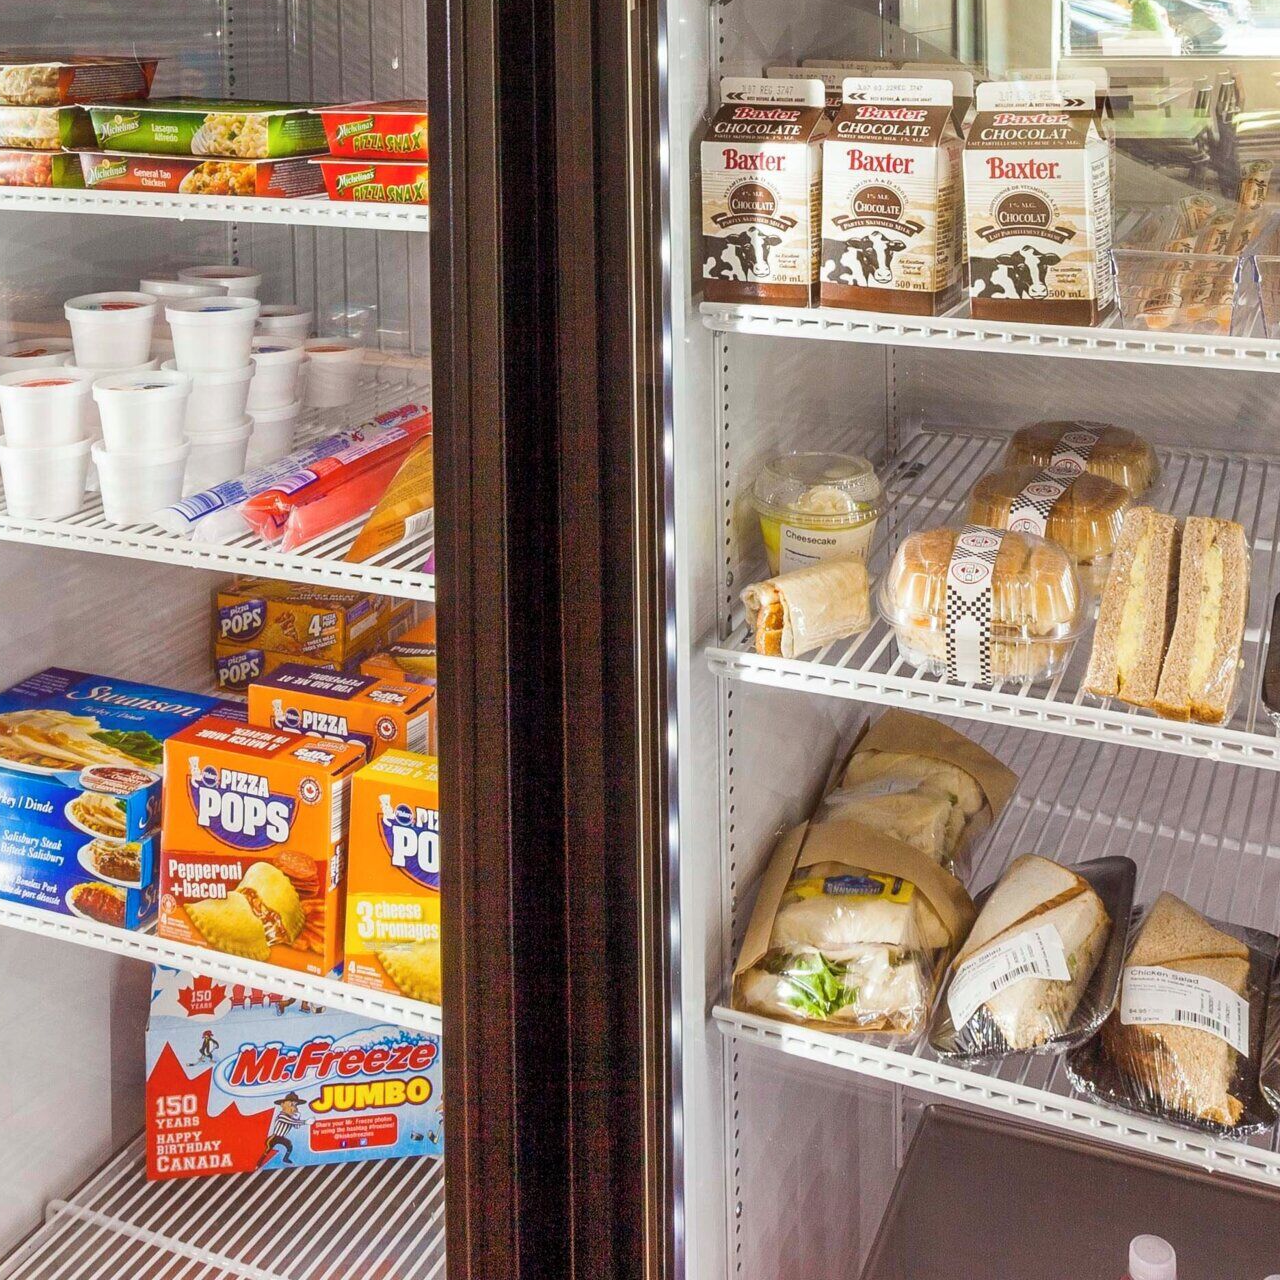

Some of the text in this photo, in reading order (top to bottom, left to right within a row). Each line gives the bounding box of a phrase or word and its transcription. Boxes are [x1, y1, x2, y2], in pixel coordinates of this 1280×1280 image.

[732, 107, 801, 121] Baxter
[855, 106, 928, 121] Baxter
[993, 113, 1069, 127] Baxter
[101, 120, 139, 140] Michelina's
[152, 124, 178, 134] Lasagna
[336, 121, 373, 139] Michelina's
[714, 122, 802, 135] CHOCOLATE
[837, 121, 931, 137] CHOCOLATE
[981, 128, 1071, 141] CHOCOLAT
[155, 133, 178, 142] Alfredo
[353, 131, 422, 153] PIZZA SNAX
[722, 148, 786, 171] Baxter
[847, 149, 914, 174] Baxter
[89, 165, 127, 184] Michelina's
[134, 169, 171, 179] General Tao
[986, 156, 1059, 180] Baxter
[141, 178, 166, 187] Chicken
[337, 171, 374, 190] Michelina's
[353, 182, 424, 202] PIZZA SNAX
[732, 198, 775, 211] CHOCOLATE
[854, 201, 900, 215] CHOCOLATE
[999, 211, 1046, 223] CHOCOLAT
[894, 224, 911, 235] MILK
[772, 273, 787, 282] 500
[895, 280, 910, 288] 500
[1048, 289, 1085, 298] 500 mL
[785, 529, 837, 546] Cheesecake
[230, 603, 249, 615] pizza
[221, 609, 262, 639] POPS
[308, 615, 322, 637] 4
[390, 645, 436, 656] Pepper
[228, 655, 247, 666] pizza
[220, 658, 259, 686] POPS
[277, 675, 293, 684] AT
[308, 680, 331, 690] HAD
[334, 683, 354, 693] YOU
[67, 685, 201, 717] Swanson
[302, 710, 348, 736] PIZZA
[195, 728, 268, 750] MATCH MADE
[220, 769, 270, 798] PIZZA
[25, 798, 53, 814] Dinde
[198, 787, 291, 843] POPS
[2, 829, 63, 851] Salisbury Steak
[0, 842, 65, 865] Bifteck Salisbury
[169, 859, 243, 882] Pepperoni
[15, 875, 41, 891] Boneless
[171, 879, 227, 899] +bacon
[22, 890, 37, 900] porc
[357, 901, 422, 940] 3 cheese
[375, 921, 439, 940] fromages
[348, 960, 357, 973] 4
[1131, 969, 1199, 984] Chicken Salad
[191, 989, 212, 1002] 150
[190, 1001, 213, 1010] YEARS
[309, 1076, 432, 1113] JUMBO
[155, 1094, 198, 1117] 150
[155, 1117, 200, 1129] YEARS
[156, 1131, 200, 1144] HAPPY
[156, 1140, 221, 1156] BIRTHDAY
[156, 1153, 233, 1172] CANADA
